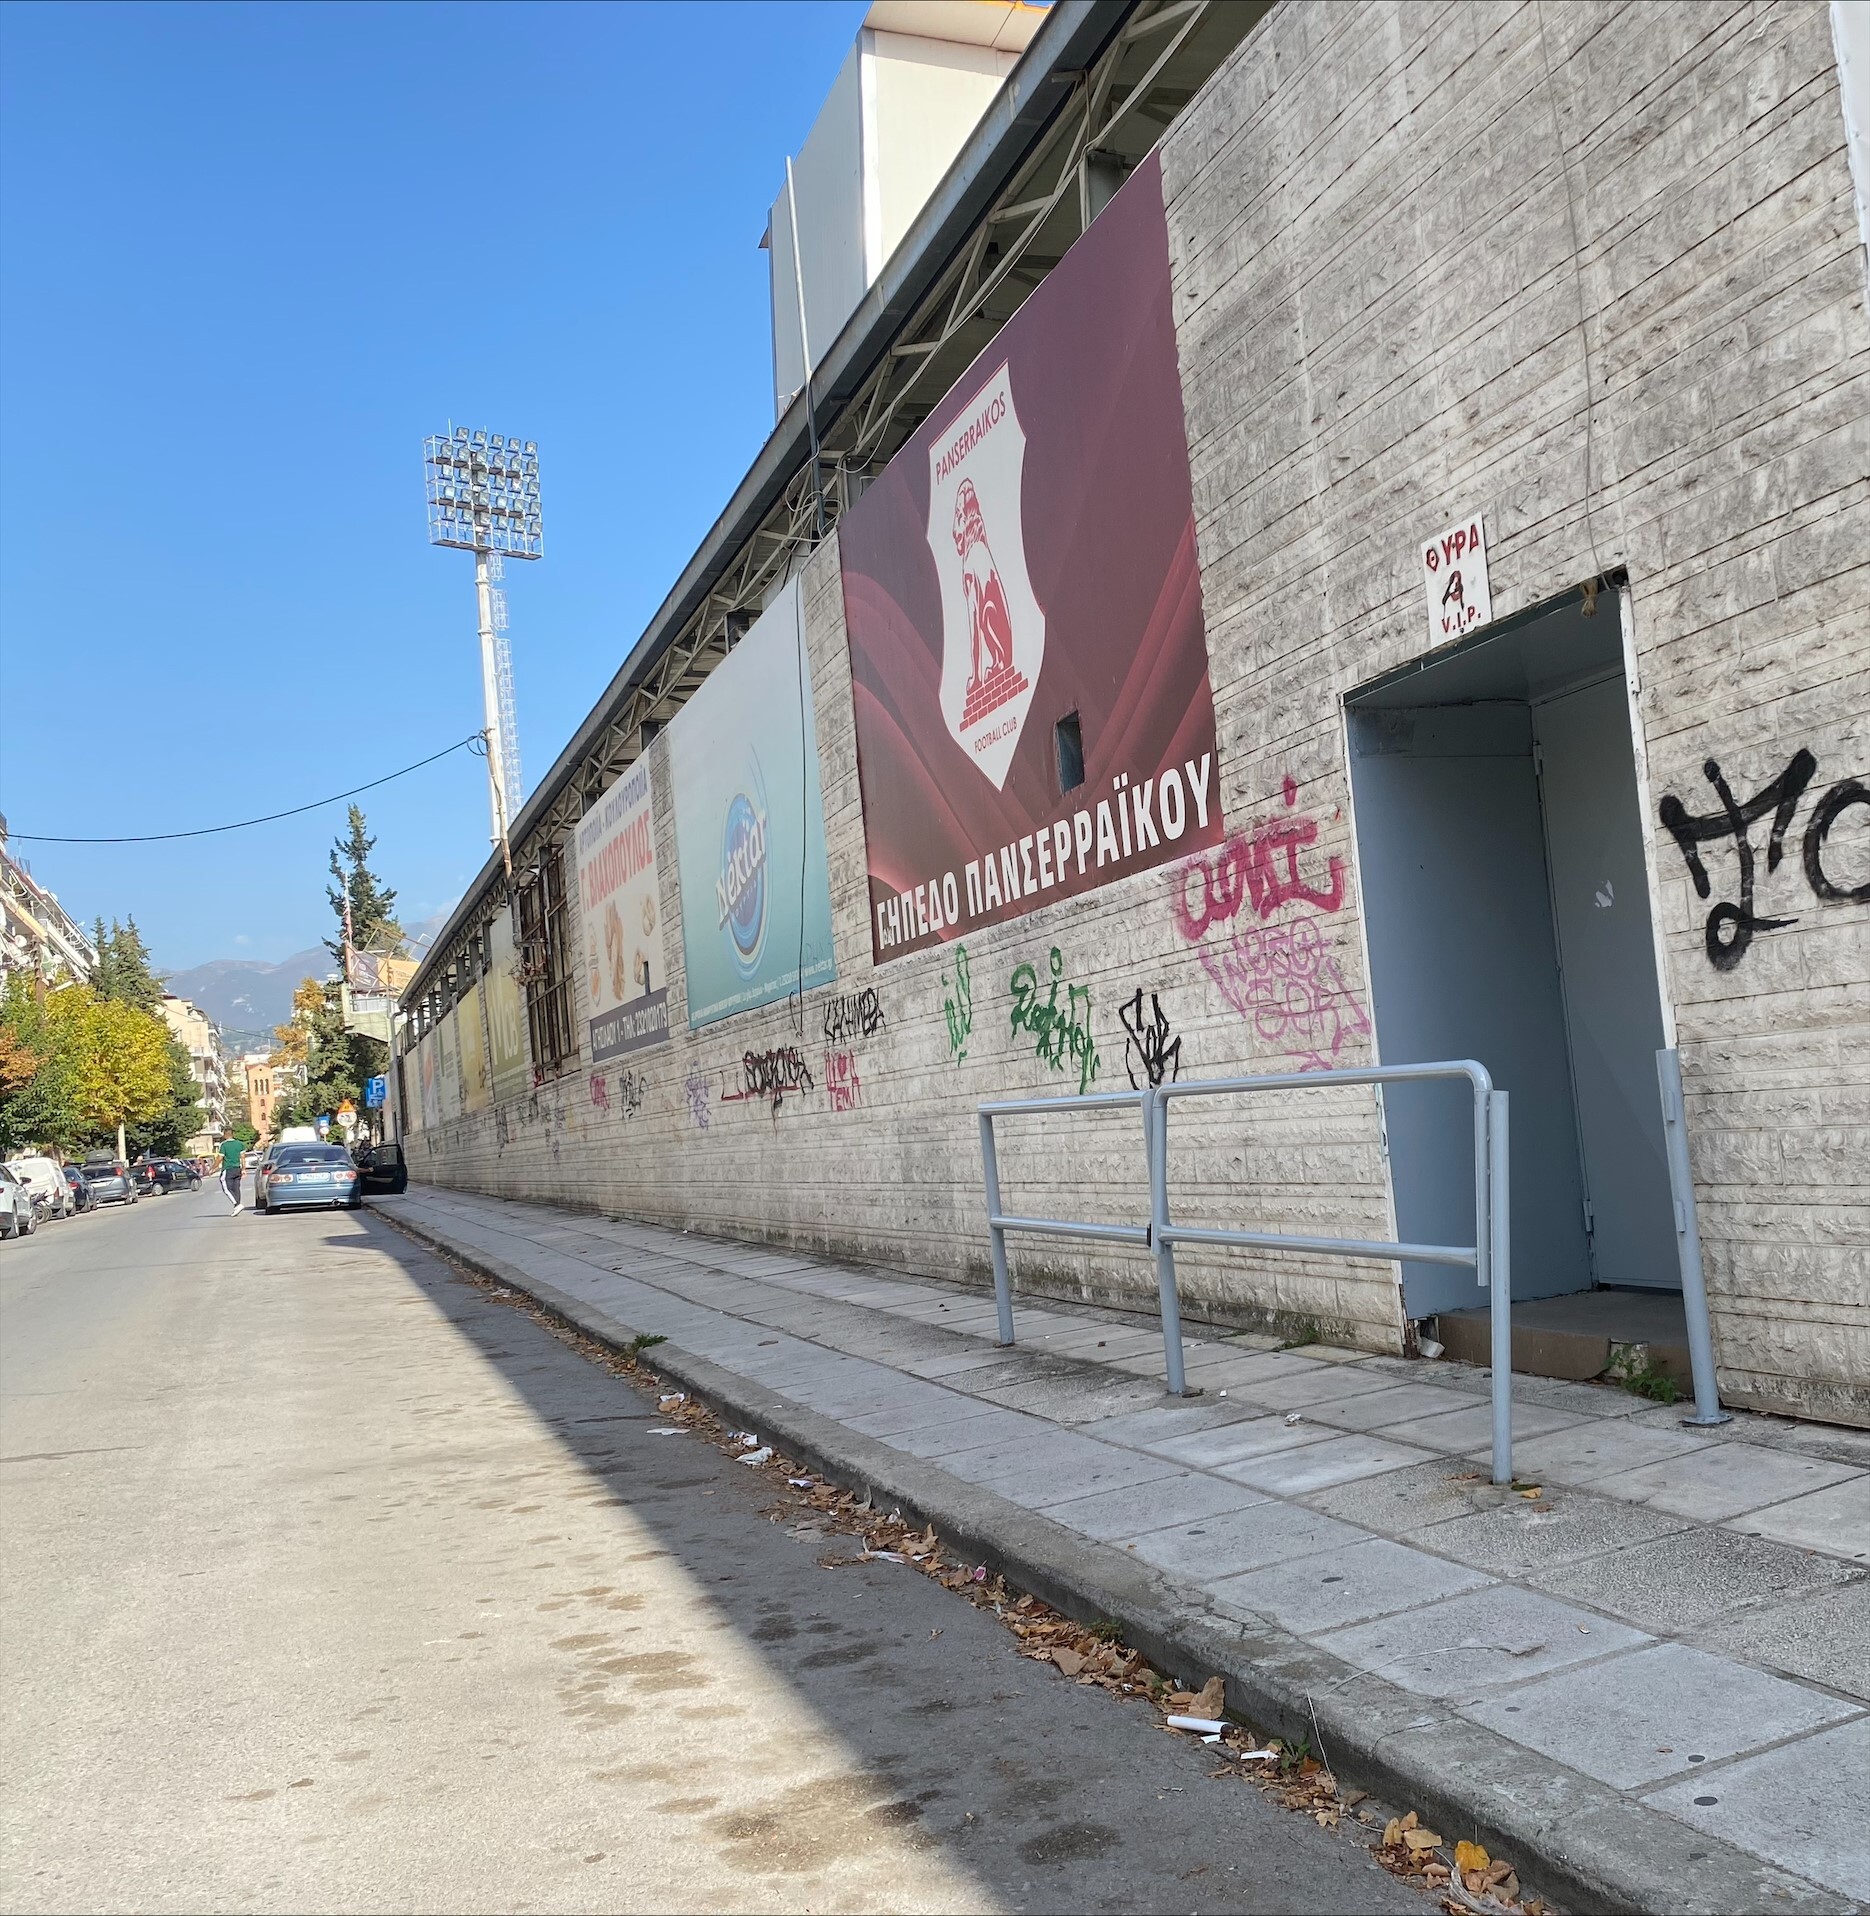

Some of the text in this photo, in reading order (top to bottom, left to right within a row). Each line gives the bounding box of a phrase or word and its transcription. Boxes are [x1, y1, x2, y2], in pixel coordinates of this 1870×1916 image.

[936, 391, 1006, 485] PANSERRAIKOS
[1441, 605, 1482, 633] V.I.P.
[974, 716, 1018, 754] FOOTBALL CLUB
[588, 808, 653, 909] ΒΛΑΧΟΠΟΥΛΟΣ
[877, 871, 959, 950] ΓΗΠΕΔΟ
[965, 752, 1211, 918] ΠΑΝΣΕΡΡΑΪΚΟΥ
[372, 1079, 384, 1094] P
